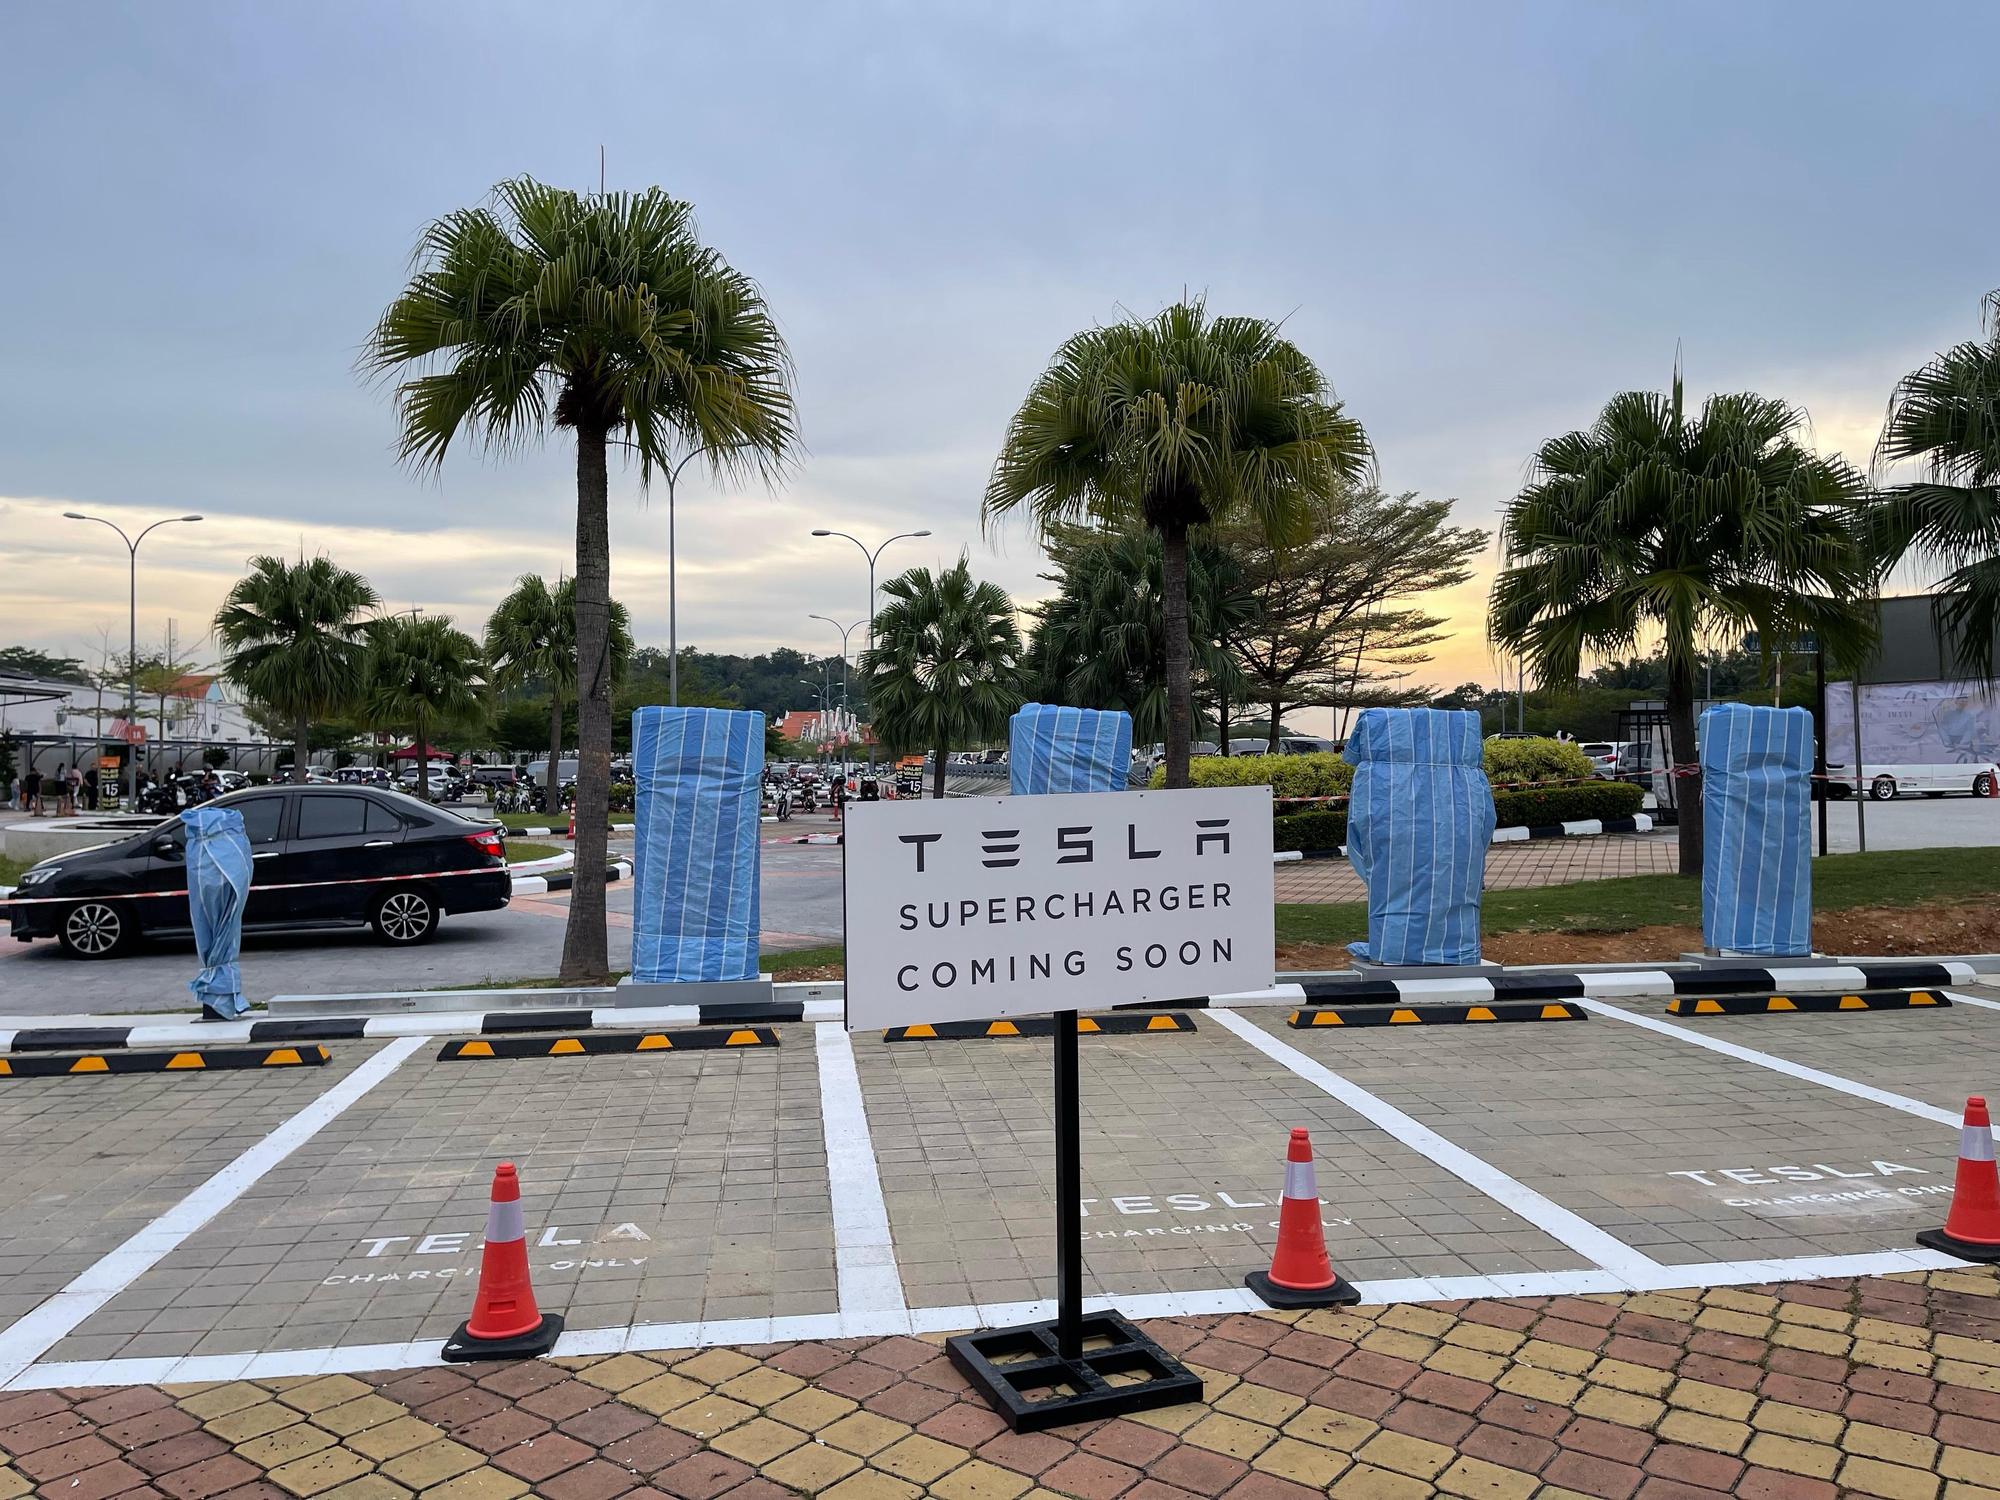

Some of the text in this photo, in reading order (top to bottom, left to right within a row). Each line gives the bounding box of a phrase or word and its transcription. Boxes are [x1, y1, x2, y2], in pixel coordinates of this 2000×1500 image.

[104, 783, 118, 796] 15
[910, 781, 921, 792] 15
[898, 819, 1230, 873] TESLA
[899, 883, 1231, 930] SUPERCHARGER
[897, 938, 1232, 991] COMING SOON
[1667, 1160, 1929, 1186] TESLA
[1055, 1189, 1330, 1216] TESL
[360, 1223, 651, 1258] TELA
[322, 1257, 648, 1286] CHARGI ONLY
